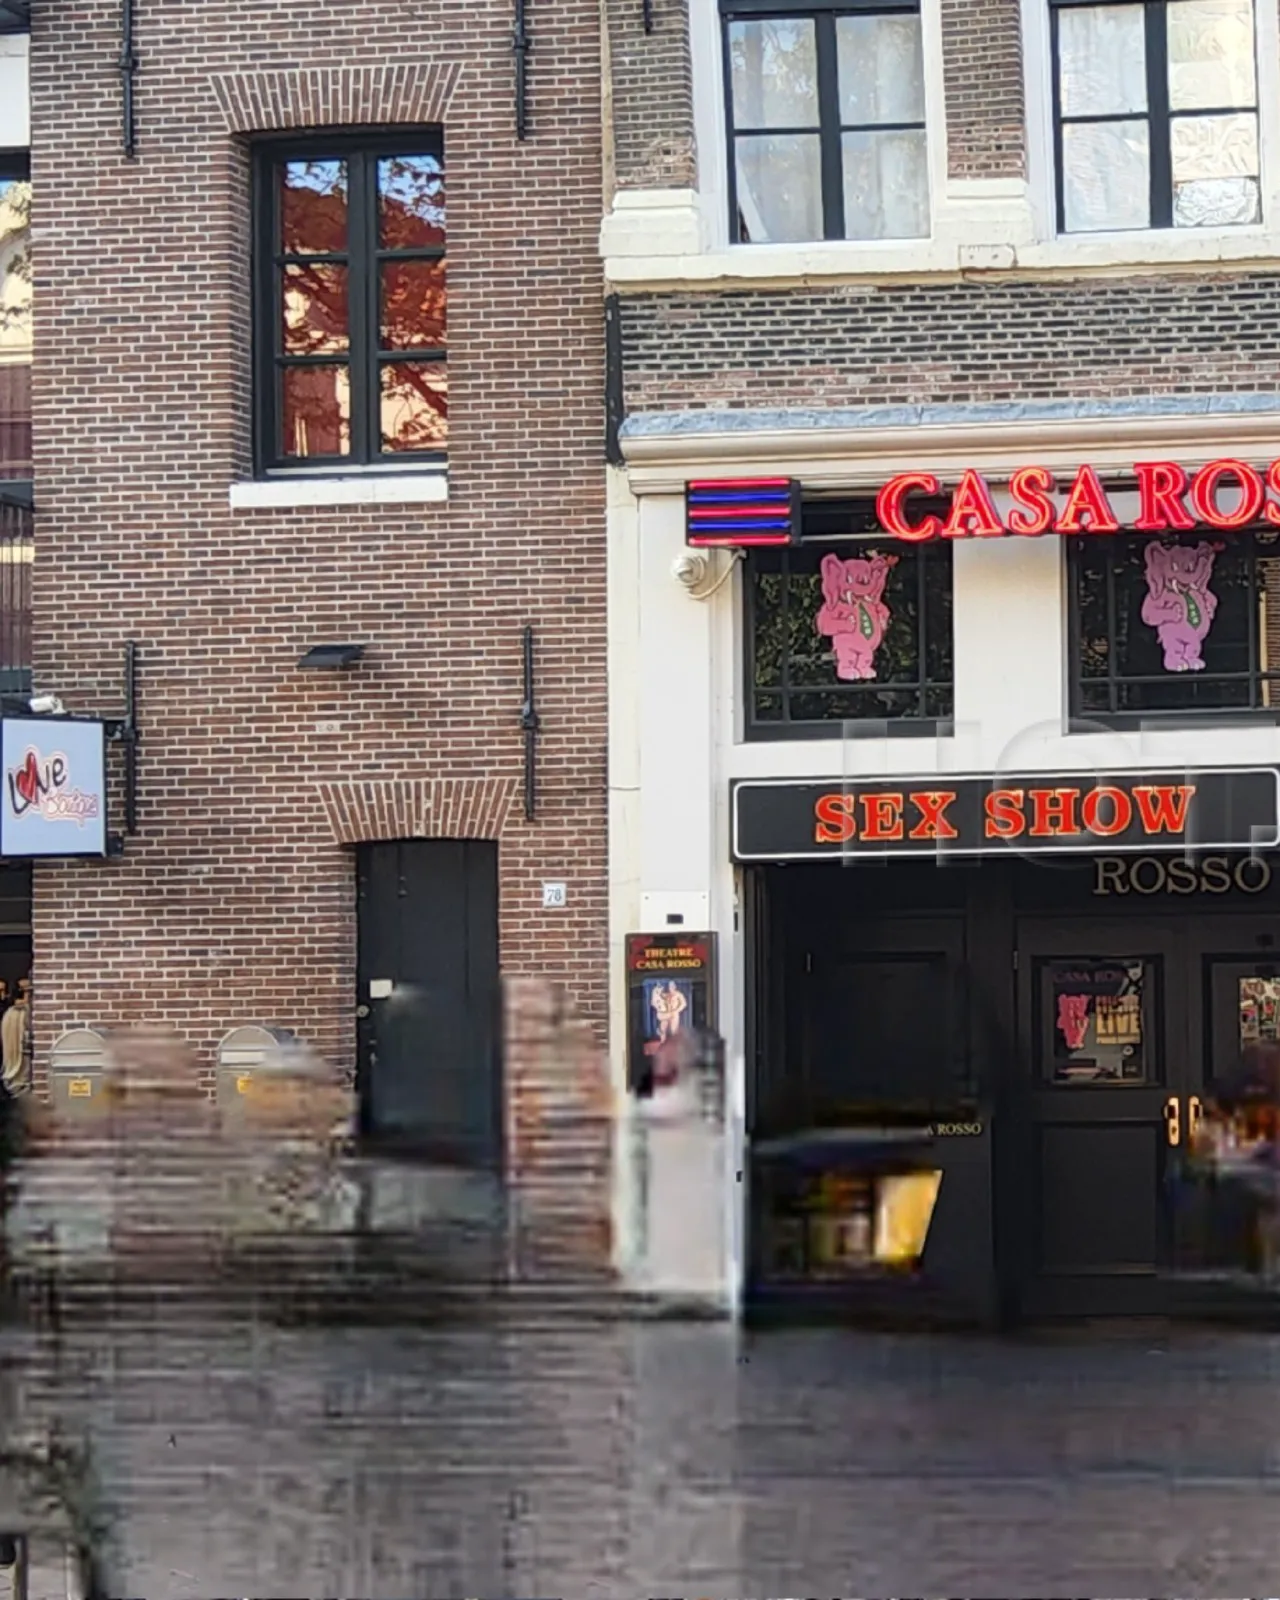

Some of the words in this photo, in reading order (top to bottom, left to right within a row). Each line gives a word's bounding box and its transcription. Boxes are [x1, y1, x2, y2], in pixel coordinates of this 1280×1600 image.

[875, 464, 1120, 542] CASA
[814, 792, 958, 843] SEX
[984, 784, 1196, 838] SHOW
[1092, 856, 1271, 895] ROSSO
[636, 960, 665, 969] CASA
[667, 959, 702, 969] ROSSO
[644, 947, 693, 958] THEATRE
[937, 1122, 982, 1137] ROSSO
